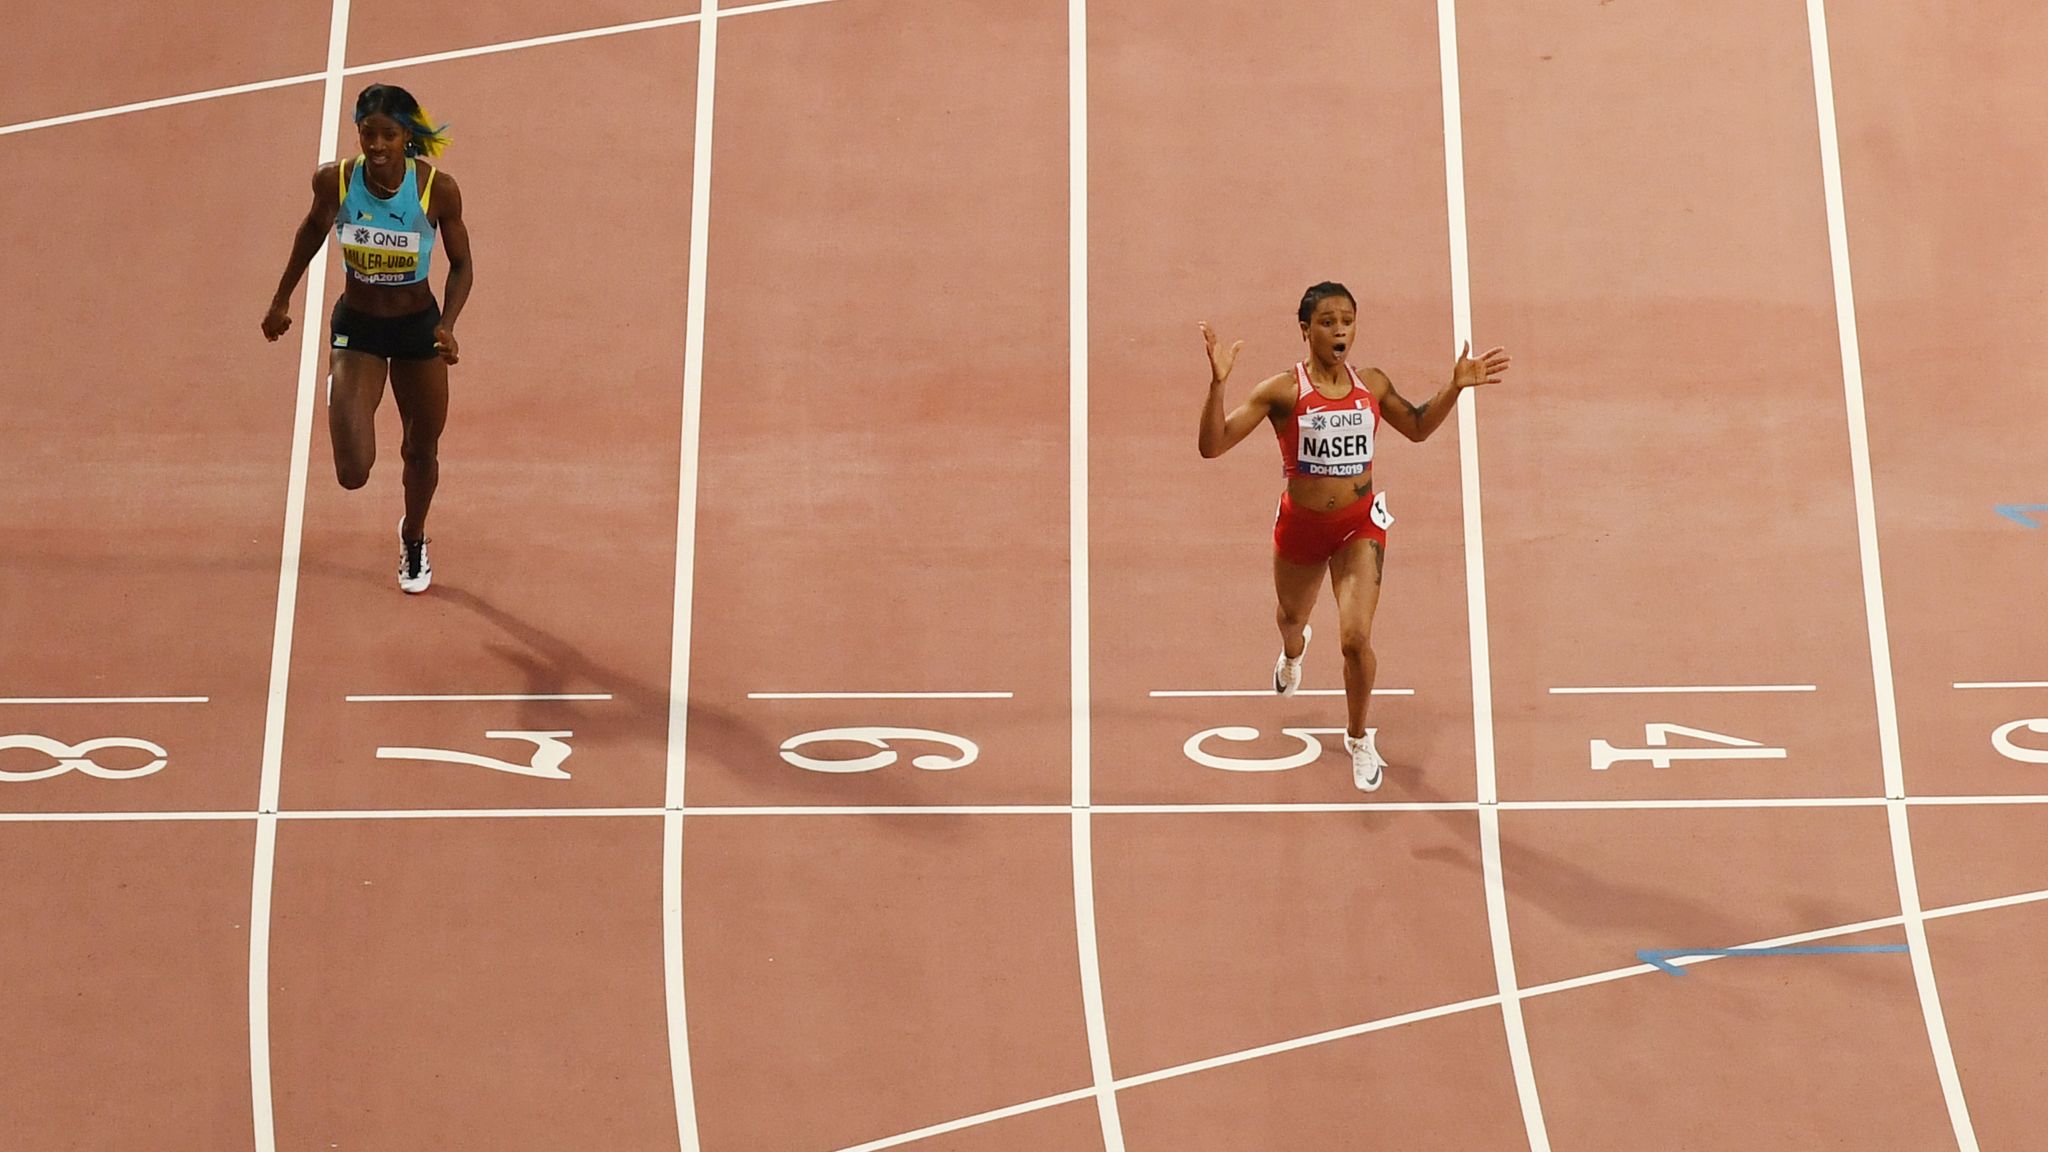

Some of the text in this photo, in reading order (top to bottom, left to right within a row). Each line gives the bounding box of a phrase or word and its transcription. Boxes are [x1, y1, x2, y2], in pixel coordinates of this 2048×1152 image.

[372, 232, 409, 248] QNB
[1329, 412, 1364, 428] QNB
[1303, 434, 1368, 458] NASER
[1310, 463, 1364, 476] DOHA2019
[0, 735, 166, 781] 8
[377, 732, 572, 778] 7
[780, 728, 978, 772] 6
[1183, 726, 1389, 771] 5
[1591, 724, 1786, 769] 4
